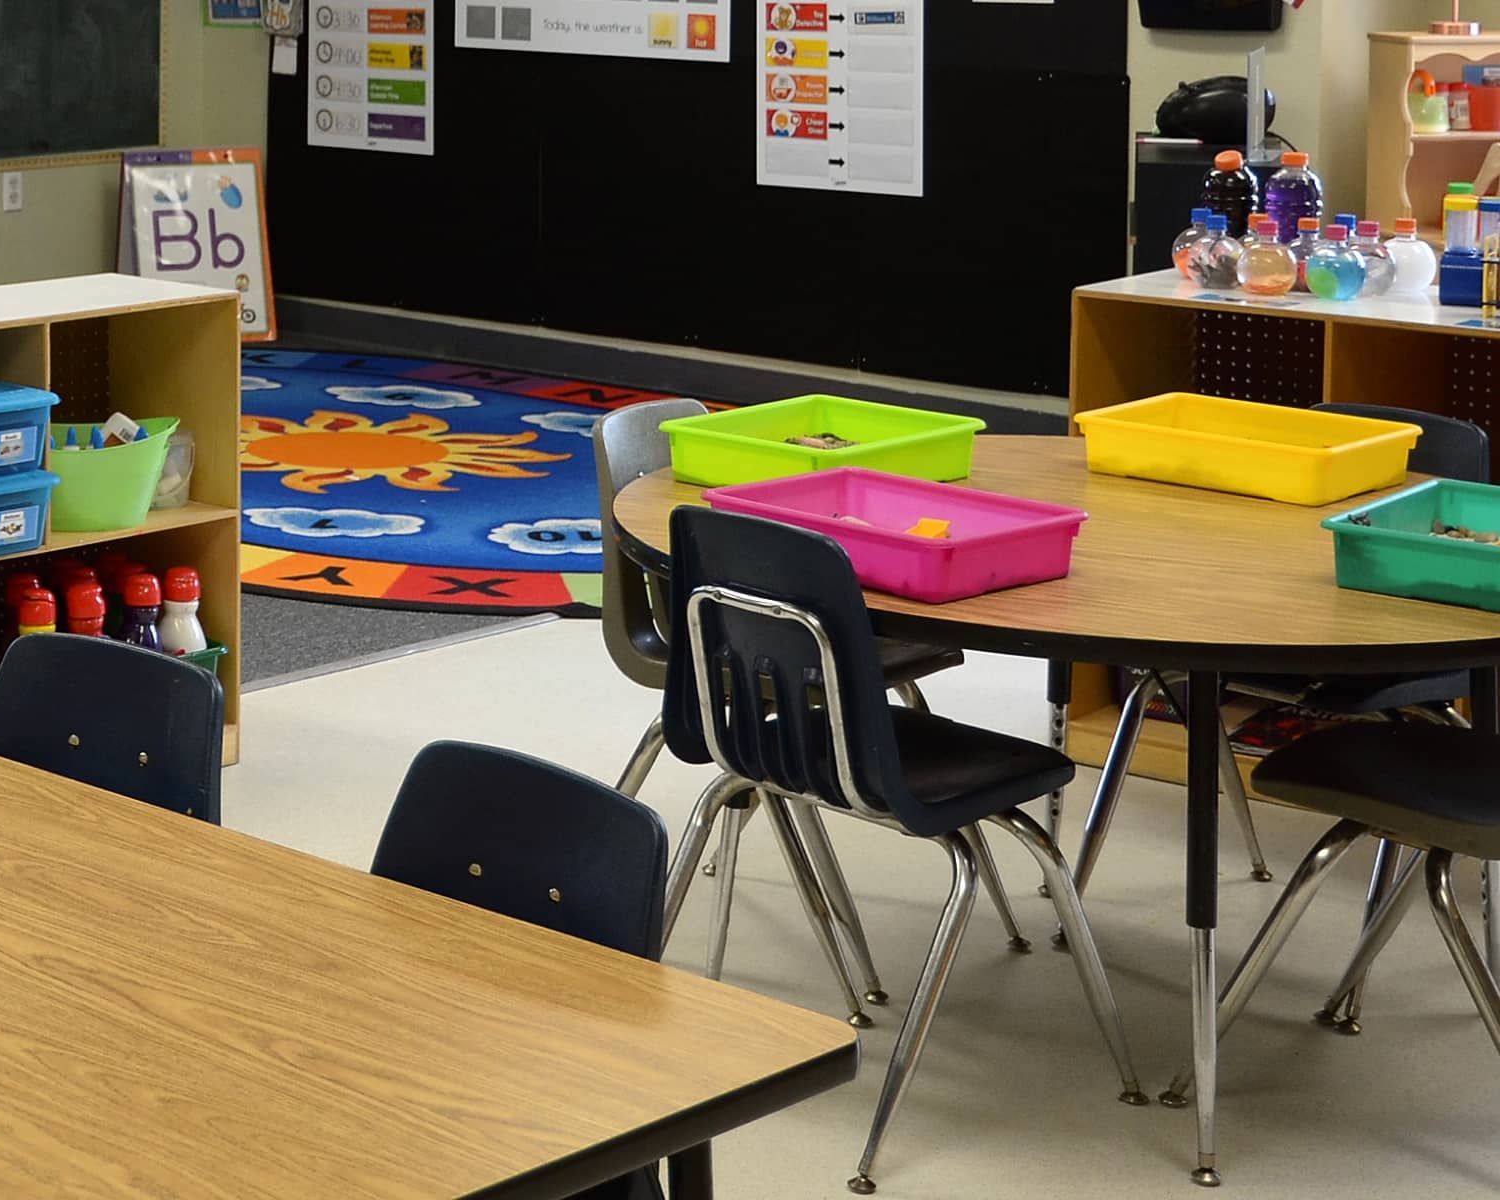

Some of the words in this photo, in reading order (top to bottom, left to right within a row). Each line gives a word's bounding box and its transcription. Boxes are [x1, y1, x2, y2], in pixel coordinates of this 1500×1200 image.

[575, 20, 590, 32] the
[593, 21, 631, 35] weather
[152, 207, 245, 272] Bb
[427, 574, 523, 599] X
